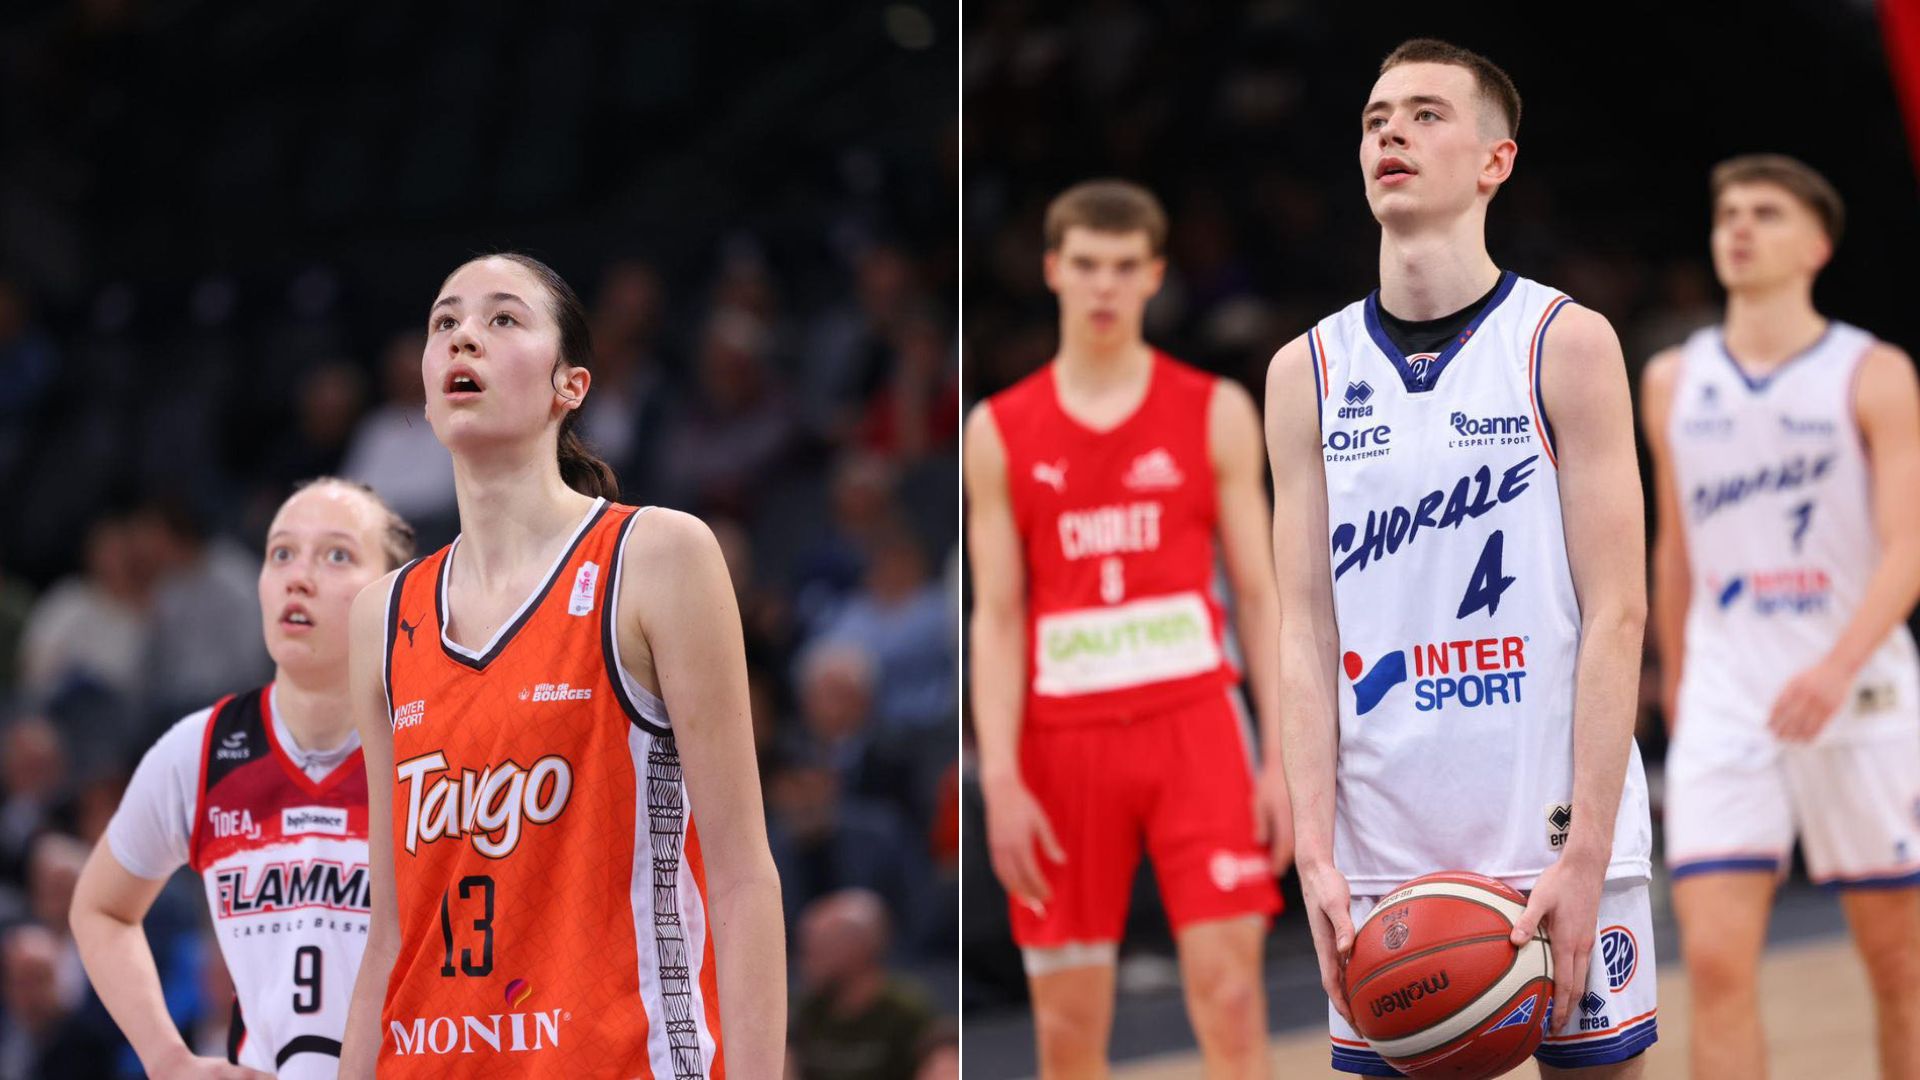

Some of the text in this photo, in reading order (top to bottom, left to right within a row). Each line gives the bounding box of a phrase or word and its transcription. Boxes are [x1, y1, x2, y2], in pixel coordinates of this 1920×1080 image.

[1338, 405, 1373, 419] errea
[1450, 411, 1529, 436] Roanne
[1323, 425, 1391, 450] oire
[1500, 435, 1531, 445] SPORT
[1326, 448, 1390, 462] DÉPARTEMENT
[1456, 530, 1516, 619] 4
[1414, 636, 1525, 677] INTER
[532, 688, 592, 702] BOURGES
[557, 683, 570, 691] de
[1415, 671, 1527, 711] SPORT
[398, 712, 424, 730] SPORT
[399, 700, 425, 717] INTER
[217, 861, 370, 916] FLAMM
[441, 875, 495, 977] 13
[293, 946, 321, 1014] 9
[1369, 969, 1449, 1018] molten
[1579, 1016, 1609, 1030] errea
